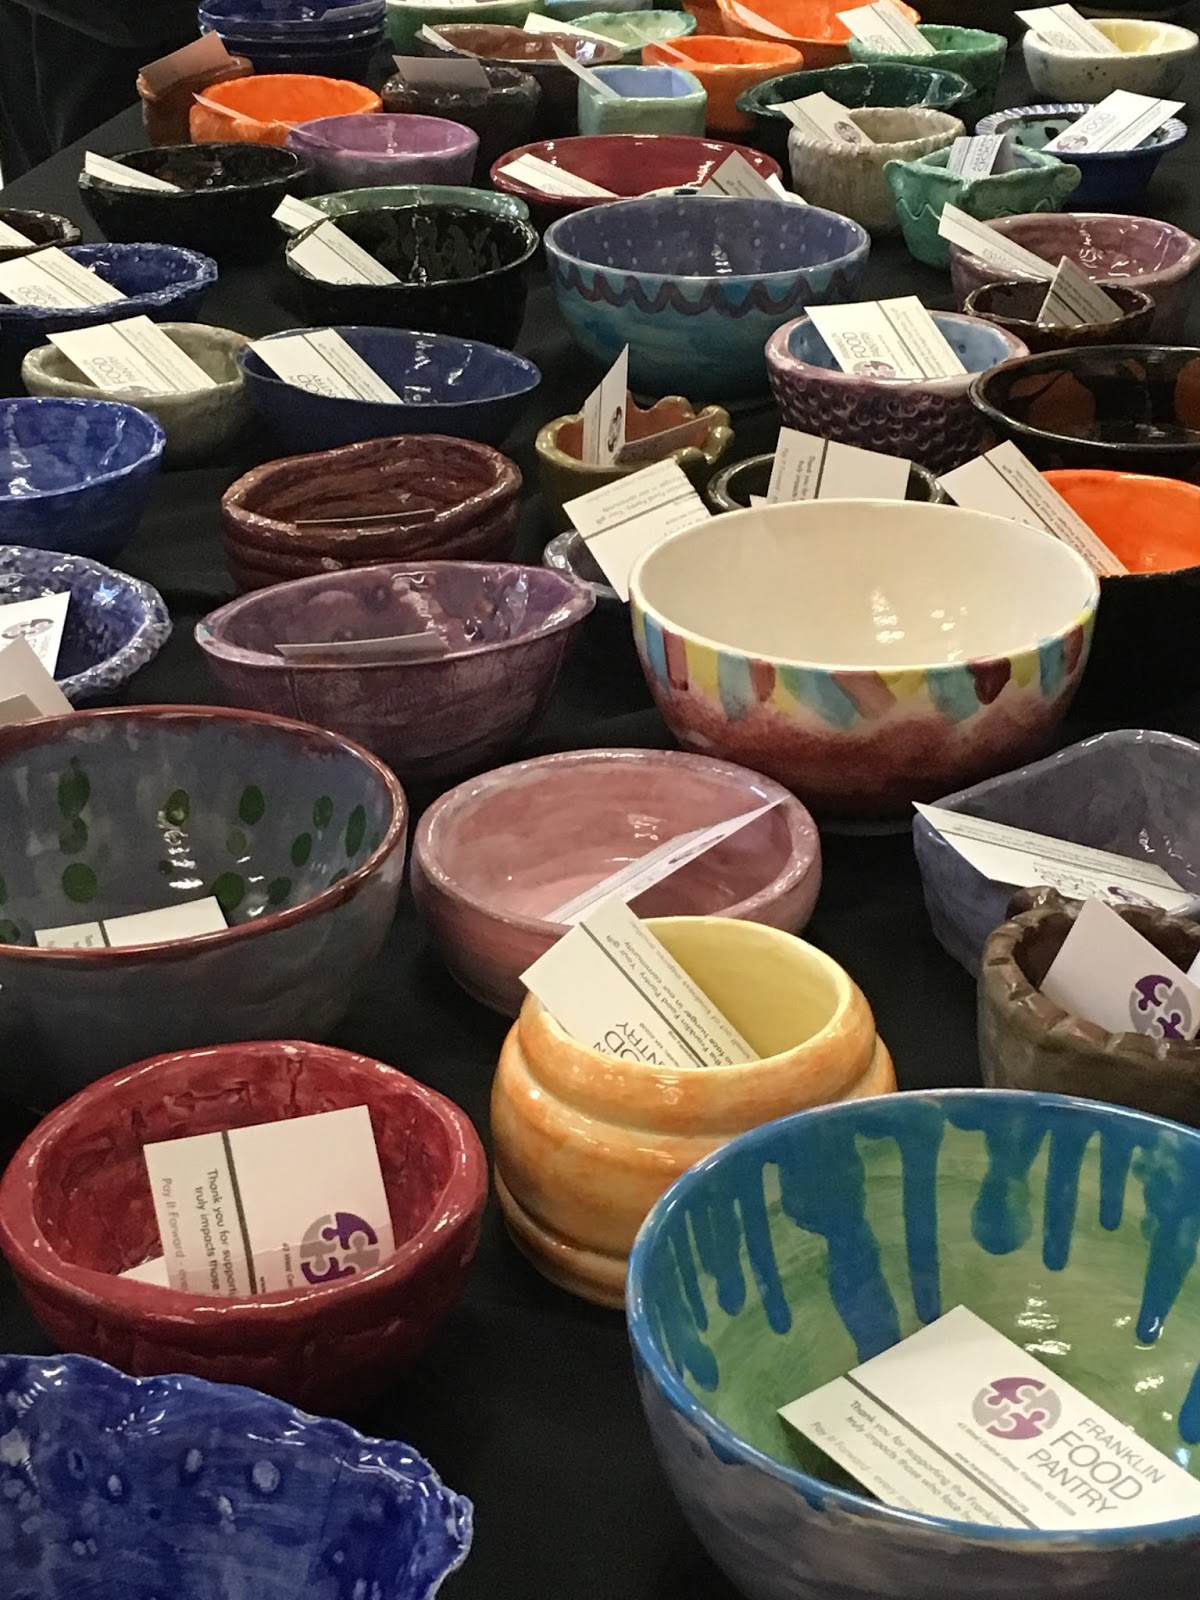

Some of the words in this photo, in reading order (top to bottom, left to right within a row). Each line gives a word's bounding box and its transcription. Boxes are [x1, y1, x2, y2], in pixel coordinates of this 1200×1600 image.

[605, 934, 620, 948] gift
[619, 949, 636, 969] Your
[624, 941, 662, 983] community
[660, 997, 680, 1019] Food
[683, 1010, 709, 1038] hunger
[680, 1018, 709, 1052] Franklin
[708, 1038, 724, 1056] face
[194, 1186, 207, 1210] truly
[207, 1168, 222, 1203] Thank
[161, 1177, 172, 1197] Pay
[168, 1211, 186, 1257] Forward
[212, 1206, 224, 1227] you
[199, 1213, 215, 1256] impacts
[219, 1229, 230, 1245] for
[208, 1259, 220, 1289] those
[850, 1400, 876, 1423] Thank
[873, 1422, 891, 1436] you
[892, 1435, 905, 1446] for
[905, 1447, 950, 1485] supporting
[1078, 1417, 1164, 1483] FRANKLIN
[1027, 1449, 1116, 1512] PANTRY
[1050, 1431, 1142, 1499] FOOD
